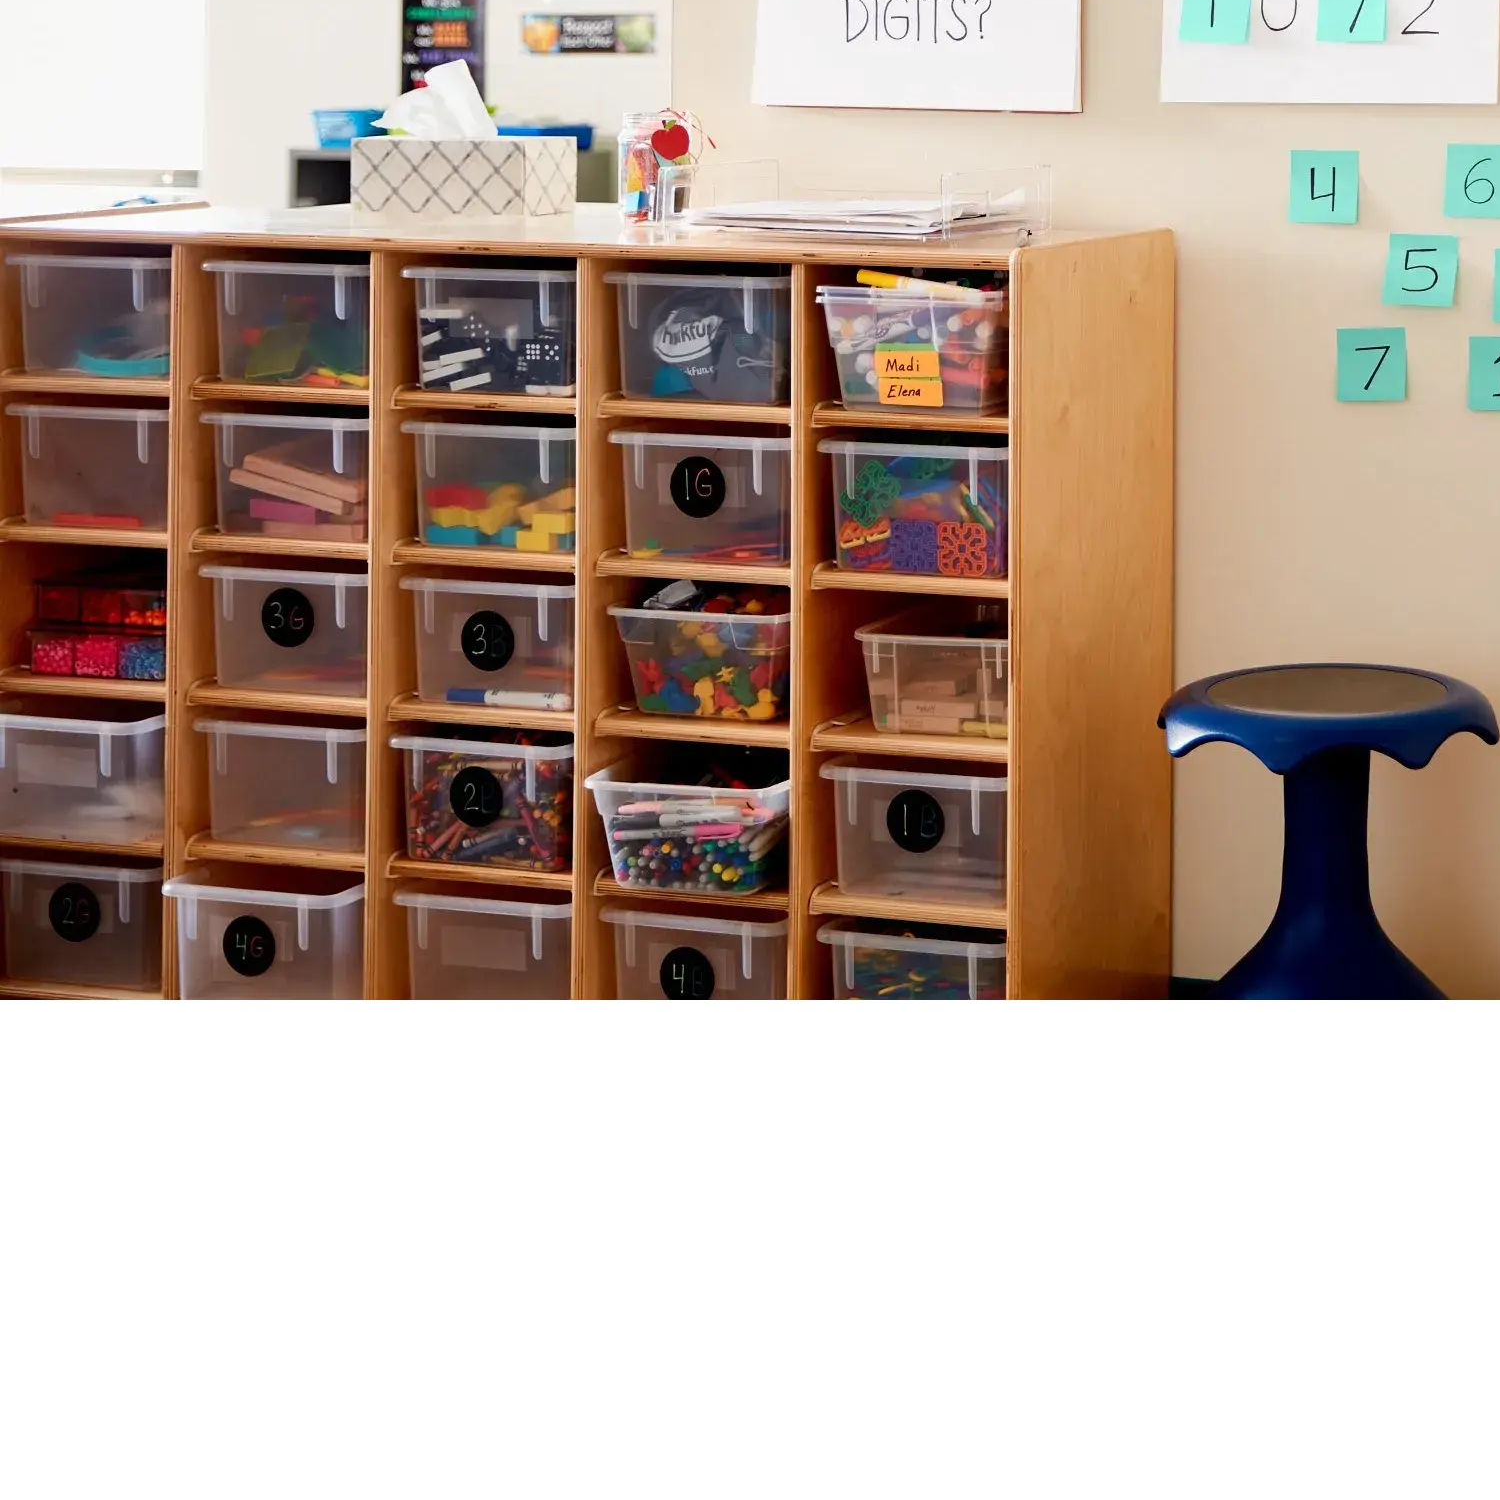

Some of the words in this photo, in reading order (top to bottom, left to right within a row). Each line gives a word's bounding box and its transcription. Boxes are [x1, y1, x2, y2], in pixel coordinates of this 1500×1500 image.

[1311, 167, 1336, 211] 4
[1464, 158, 1495, 204] 6
[1402, 248, 1439, 292] 5
[885, 355, 920, 372] Madi
[1355, 346, 1391, 391] 7
[887, 384, 921, 398] Elena
[685, 468, 712, 500] 1G
